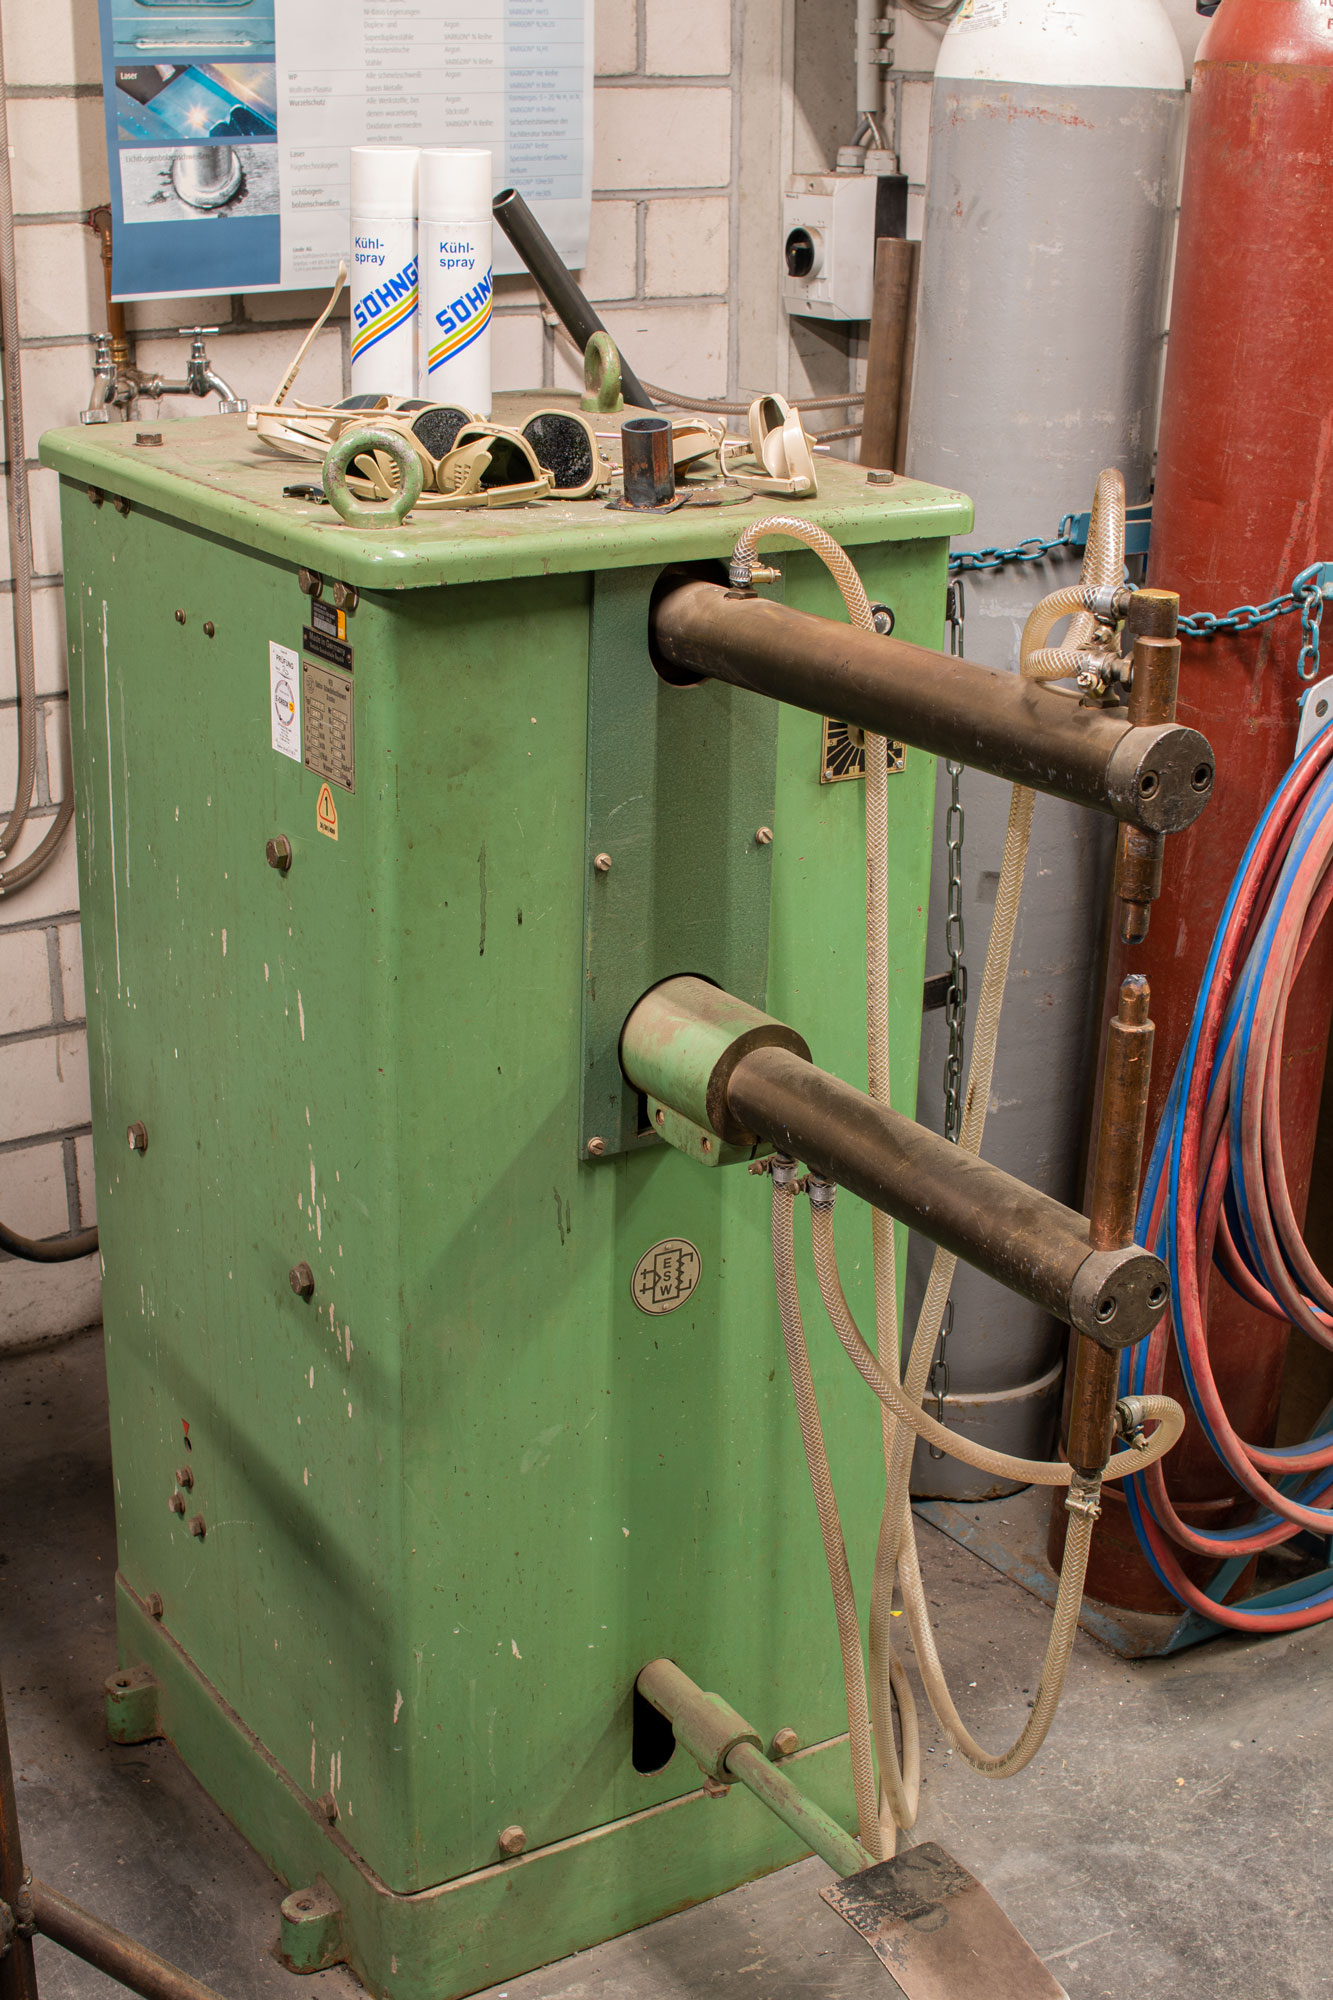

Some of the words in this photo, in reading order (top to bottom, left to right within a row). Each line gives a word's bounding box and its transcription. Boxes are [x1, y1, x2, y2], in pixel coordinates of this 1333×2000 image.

[444, 21, 460, 29] Argon
[444, 46, 461, 54] Argon
[446, 71, 462, 79] Argon
[289, 99, 326, 107] Wurzelschutz
[446, 96, 462, 104] Argon
[292, 188, 324, 196] Lichtbogen-
[292, 200, 340, 208] bolzenschweißen
[355, 237, 384, 249] Kühl-
[440, 242, 474, 254] Kühl-
[355, 253, 385, 266] spray
[440, 258, 475, 270] spray
[353, 254, 418, 328] SÖHNG
[276, 654, 294, 670] PRÜFUNG
